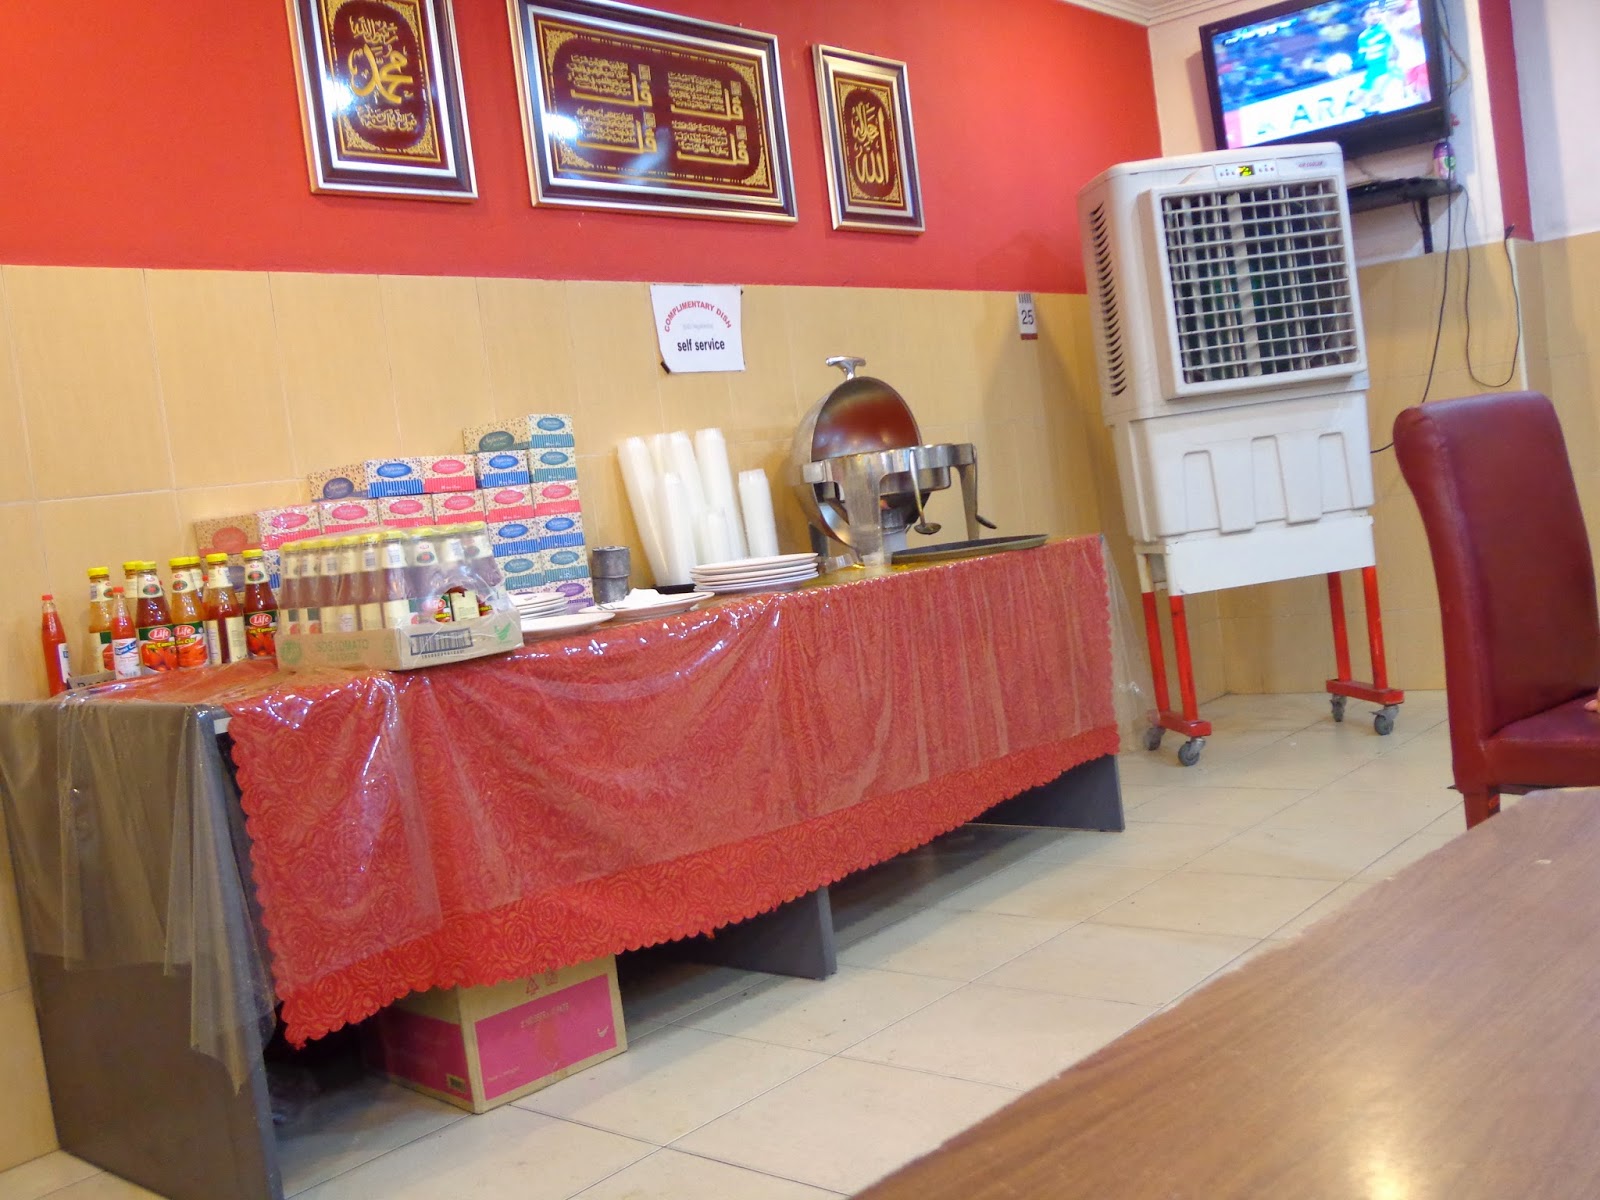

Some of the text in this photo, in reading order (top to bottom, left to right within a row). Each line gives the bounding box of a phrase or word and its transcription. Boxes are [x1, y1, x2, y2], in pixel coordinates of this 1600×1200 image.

[664, 301, 732, 332] COMPLIMENTARY DISH
[1021, 309, 1034, 325] 25
[677, 338, 725, 352] self service
[254, 615, 269, 626] Life
